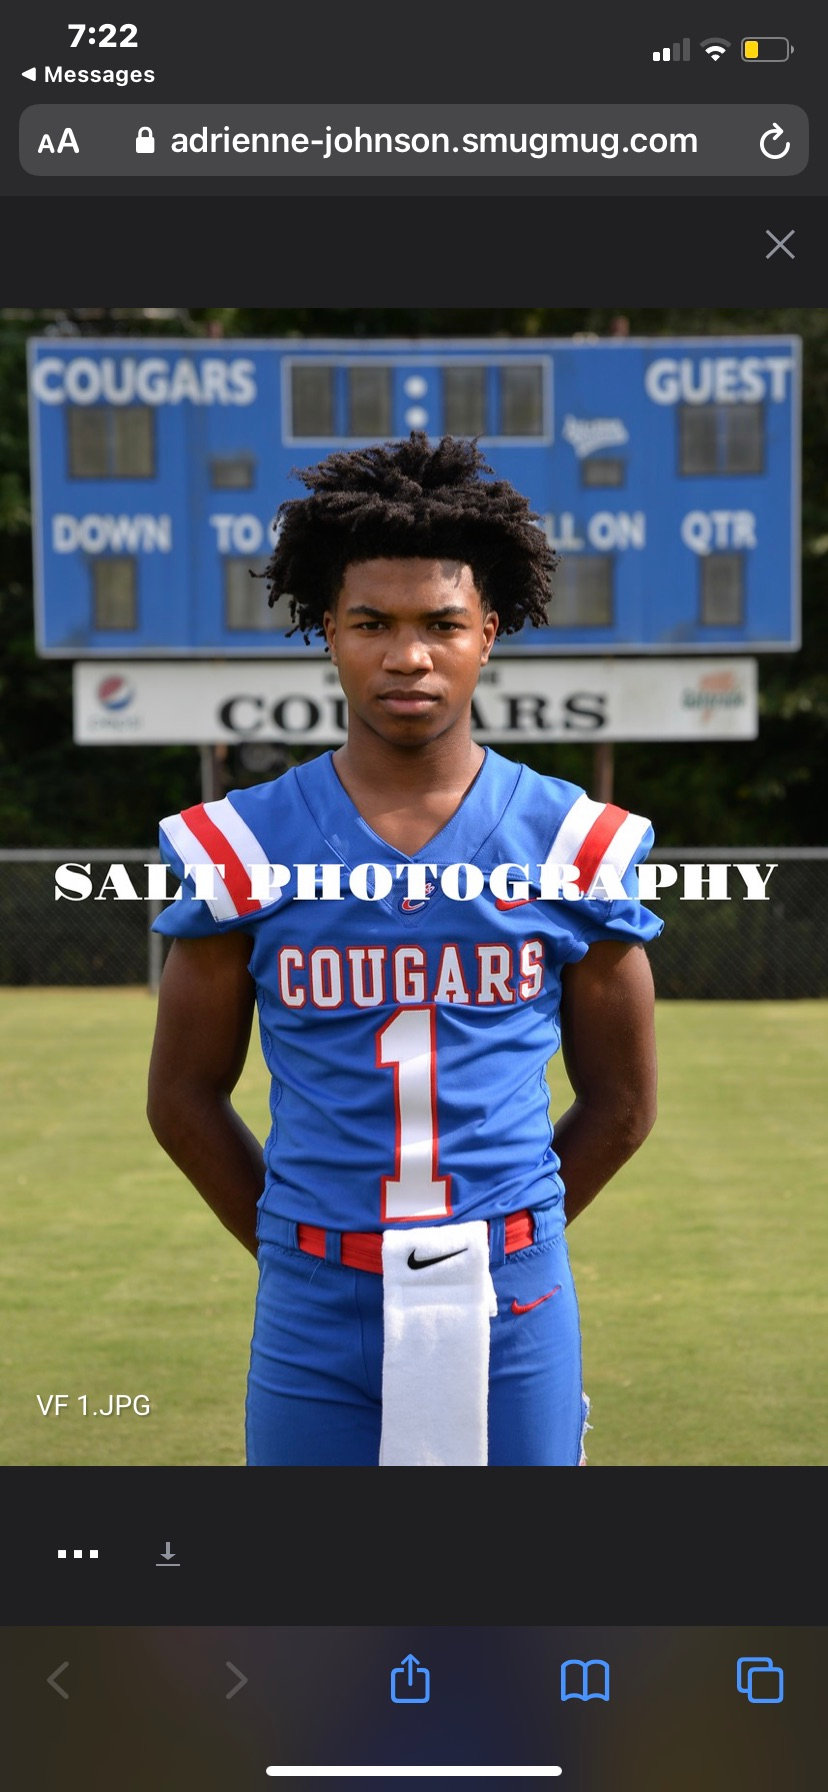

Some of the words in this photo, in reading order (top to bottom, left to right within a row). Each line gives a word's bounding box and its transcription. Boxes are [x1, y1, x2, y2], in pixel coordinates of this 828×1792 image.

[67, 23, 139, 48] 7:22
[43, 64, 156, 87] Messages
[37, 126, 80, 155] AA
[170, 125, 699, 159] adrienne-johnson.smugmug.com
[32, 356, 257, 406] COUGARS
[645, 355, 793, 405] GUEST
[52, 513, 172, 554] DOWN
[210, 512, 263, 555] TO
[530, 511, 585, 551] LL
[588, 511, 646, 552] ON
[681, 509, 757, 556] QTR
[217, 692, 609, 734] CORS
[278, 938, 546, 1010] COUGARS
[375, 1004, 454, 1223] 1
